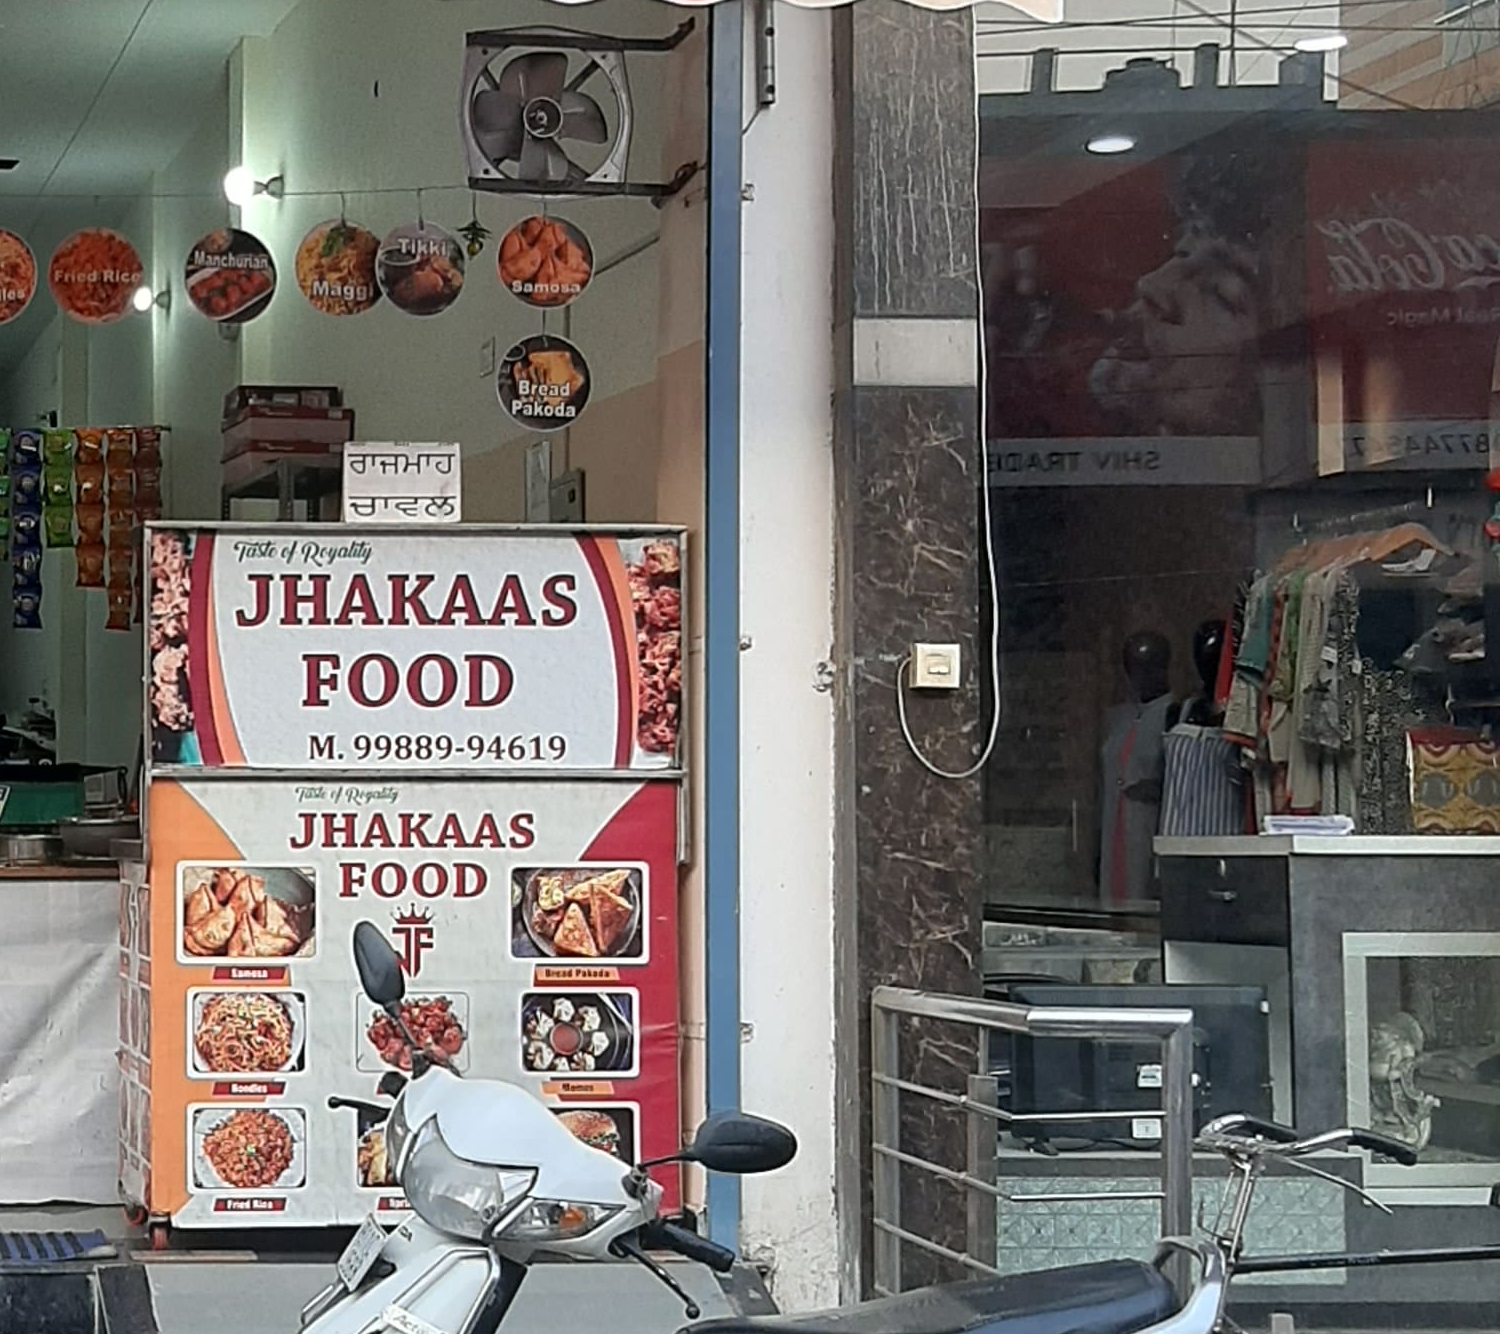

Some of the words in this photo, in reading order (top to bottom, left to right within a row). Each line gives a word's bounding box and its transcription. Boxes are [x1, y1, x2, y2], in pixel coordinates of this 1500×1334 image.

[194, 251, 269, 268] Manchurian
[511, 279, 582, 295] Samosa
[518, 379, 571, 397] Bread
[511, 399, 577, 418] Pakoda
[348, 496, 457, 517] ਚਾਵਲ
[235, 573, 578, 627] JHAKAAS
[301, 653, 514, 708] FOOD
[308, 735, 344, 760] M.
[353, 734, 567, 762] 99889-94619
[289, 813, 536, 849] JHAKAAS
[339, 862, 488, 899] FOOD
